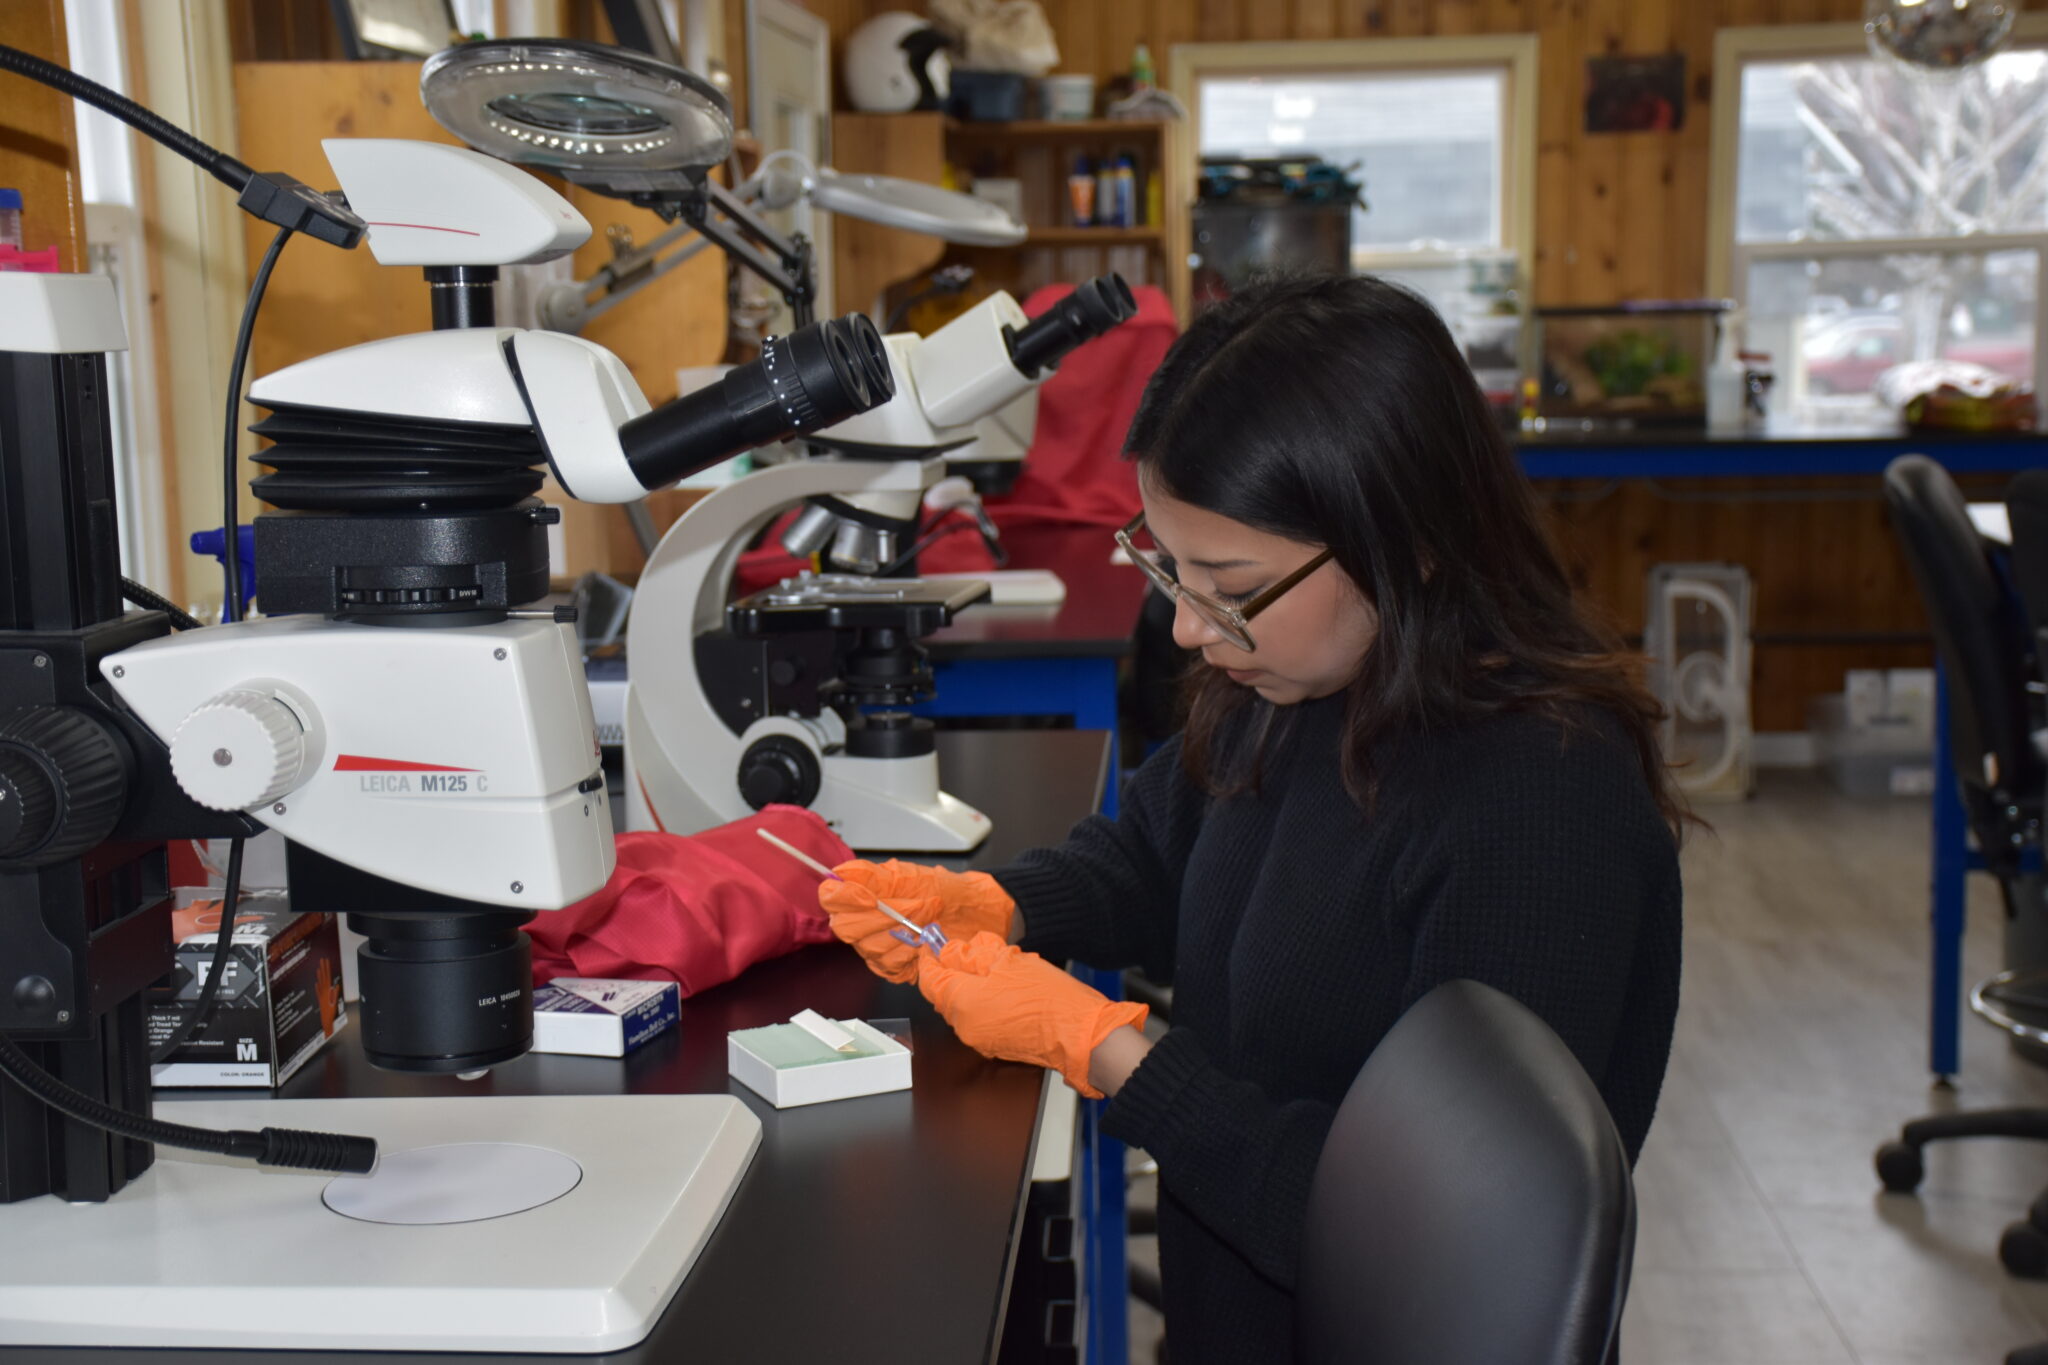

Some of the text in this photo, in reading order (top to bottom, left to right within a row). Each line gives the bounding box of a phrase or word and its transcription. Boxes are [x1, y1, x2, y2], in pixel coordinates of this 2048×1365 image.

[360, 775, 488, 792] LEICA M125 C
[478, 996, 497, 1007] LEICA
[236, 1043, 258, 1061] M
